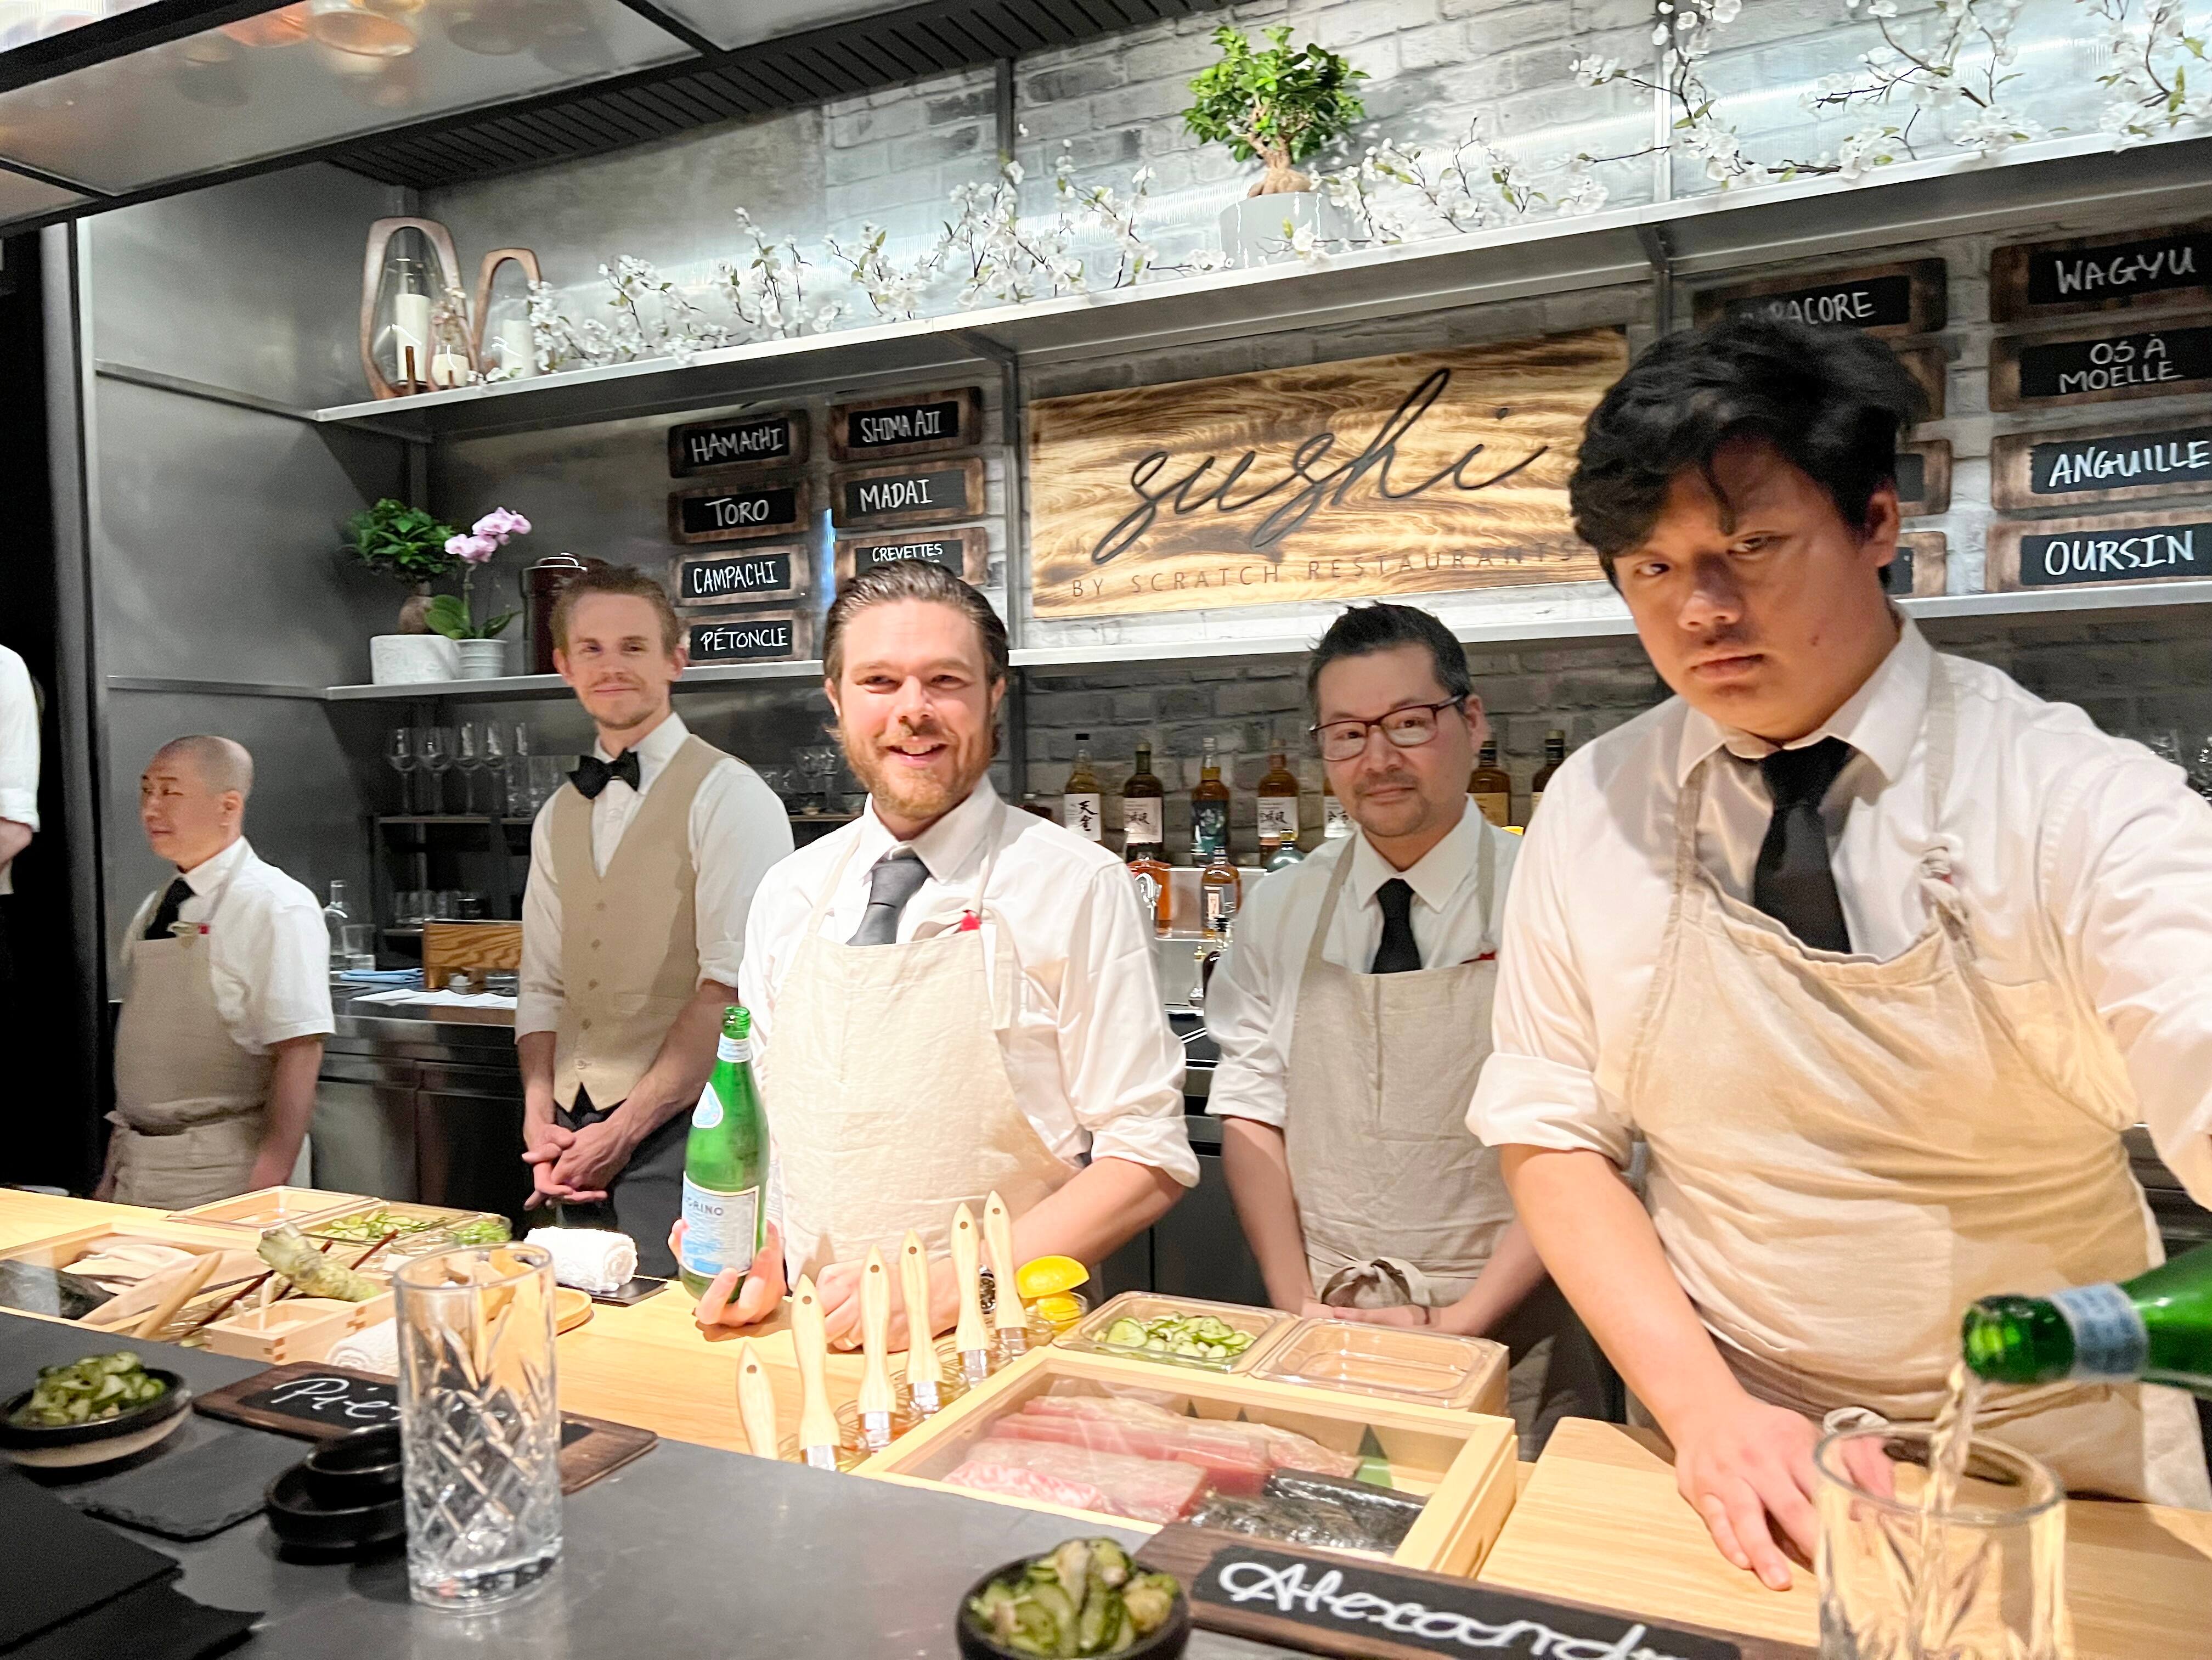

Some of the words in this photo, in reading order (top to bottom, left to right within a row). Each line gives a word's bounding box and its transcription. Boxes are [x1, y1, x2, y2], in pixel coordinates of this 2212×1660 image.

[2055, 247, 2196, 294] WAGYU
[2090, 340, 2136, 365] OS
[2059, 361, 2185, 393] MOELLE
[691, 426, 783, 463] HAMACHI
[2049, 440, 2211, 487] ANGUILLE
[704, 497, 769, 527] TORO
[859, 479, 933, 512] MADAI
[872, 543, 944, 562] CREVETTES
[1072, 577, 1104, 598] BY
[1132, 563, 1278, 594] SCRATCH
[1308, 539, 1571, 581] RESTAURANTS
[2044, 530, 2194, 576] OURSIN
[693, 561, 778, 594] CAMPACHI
[699, 627, 788, 652] PÉTONCLE
[270, 1378, 402, 1421] Pie
